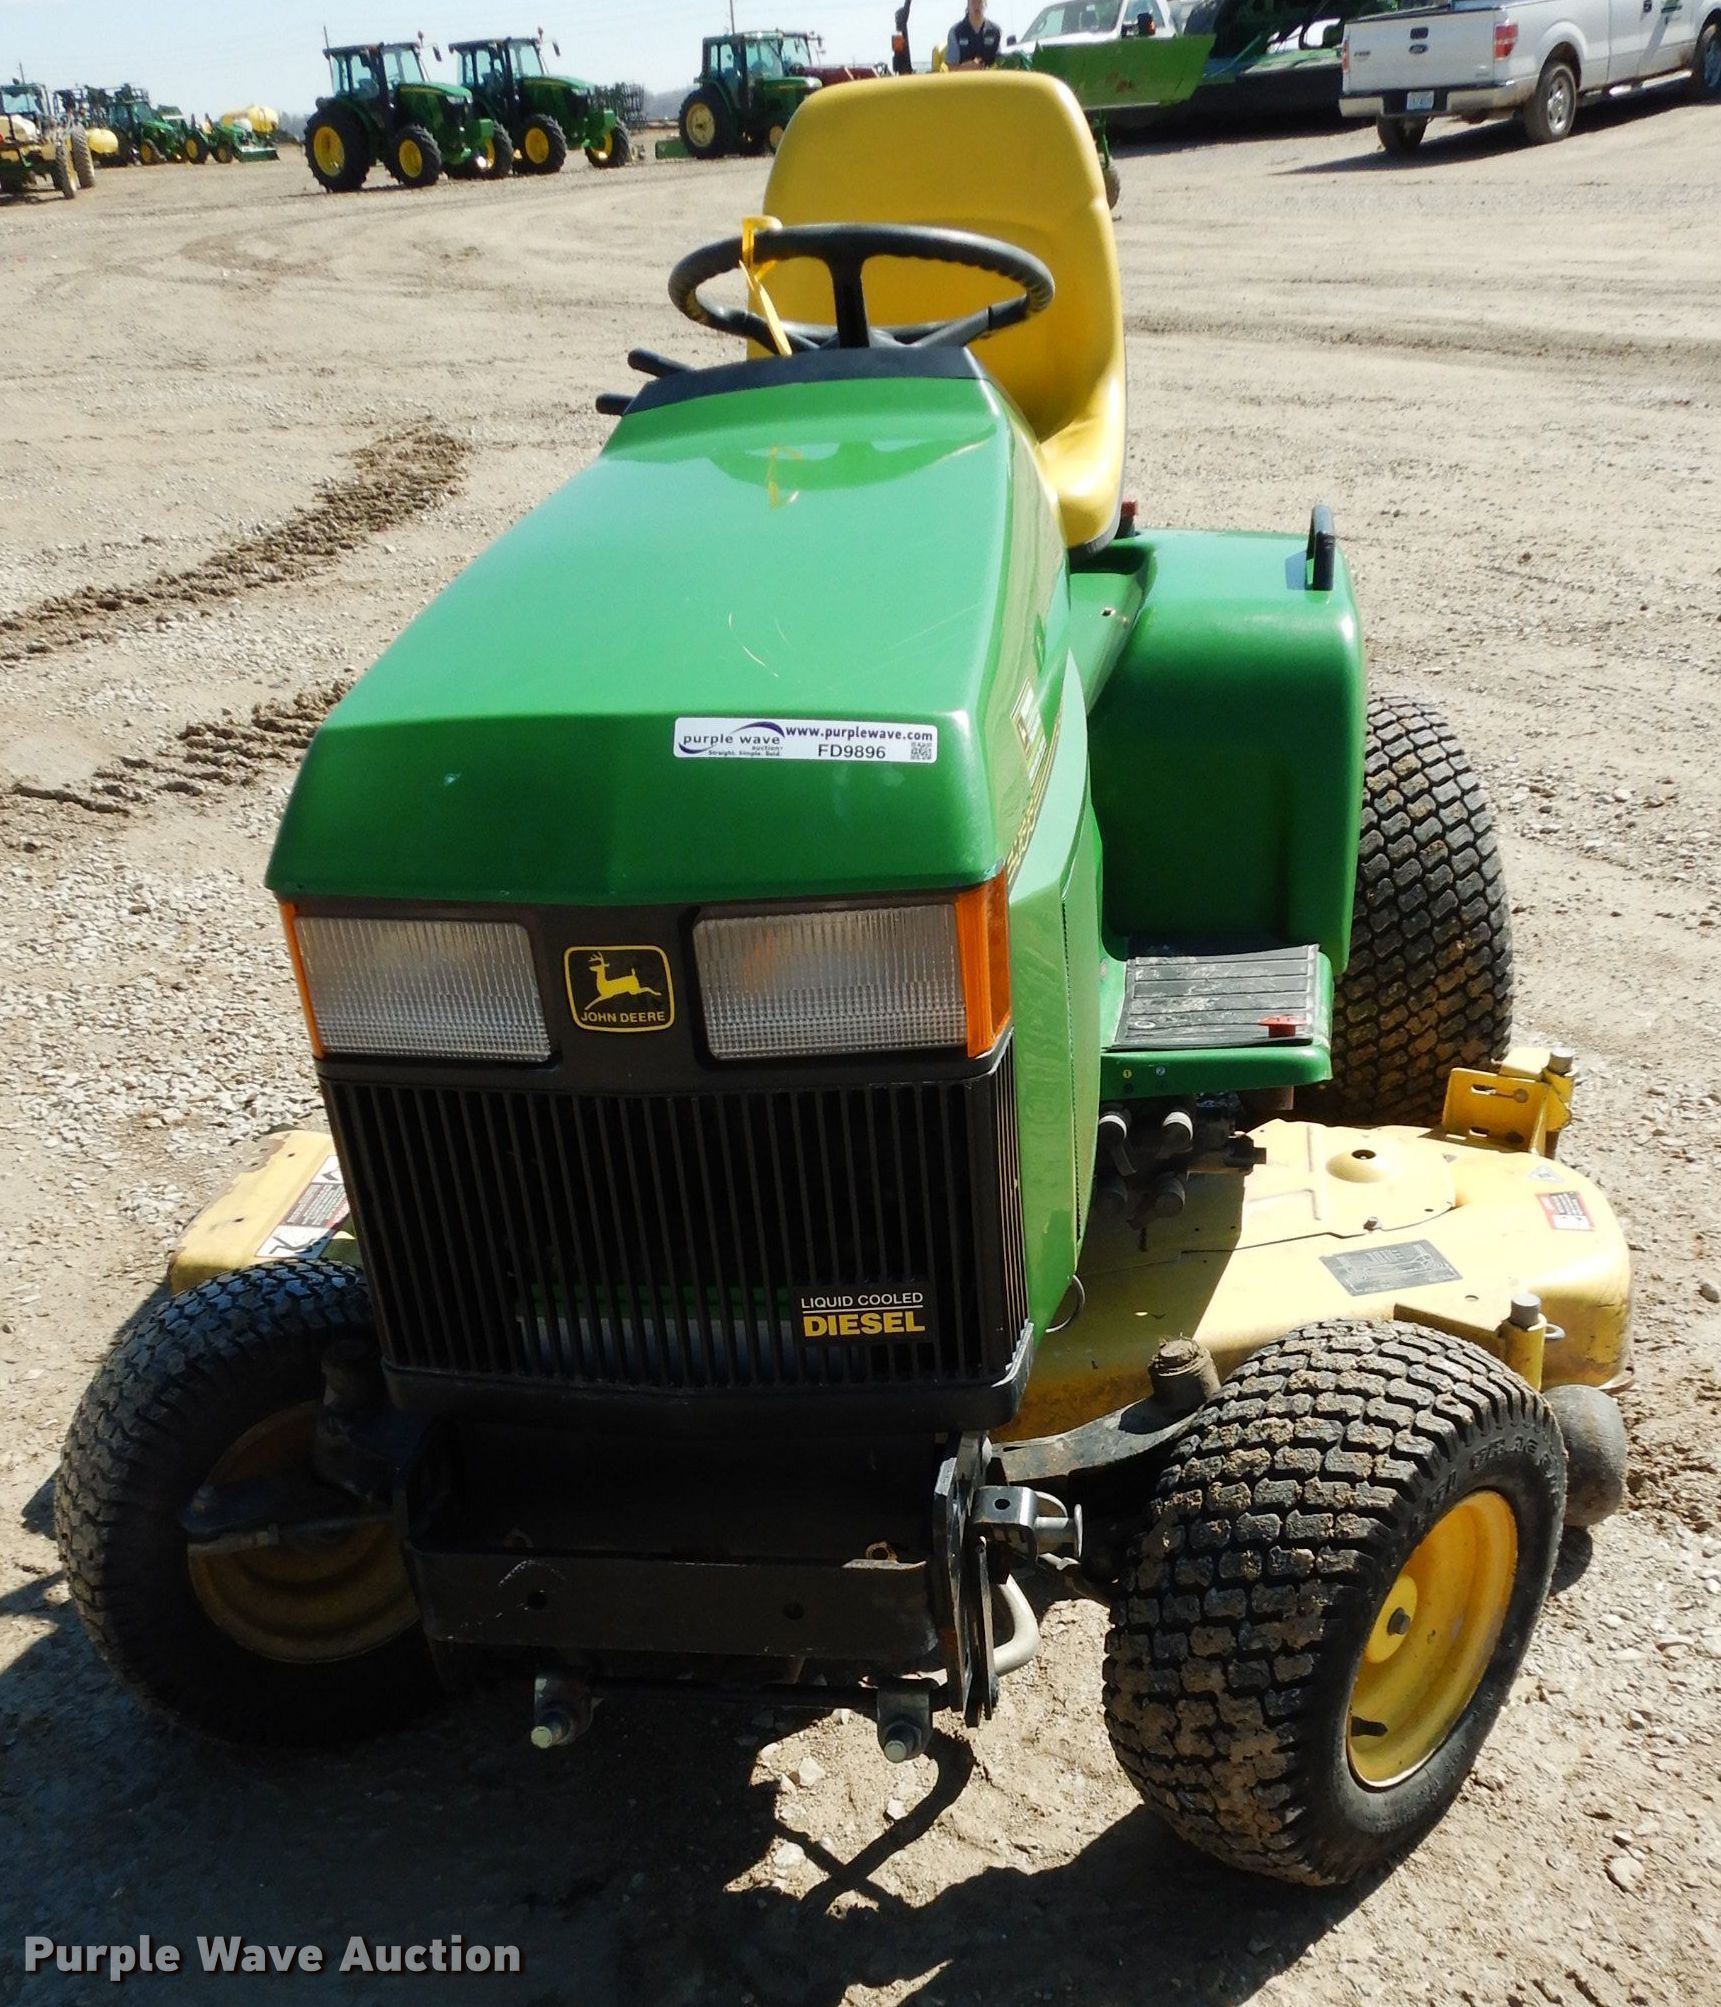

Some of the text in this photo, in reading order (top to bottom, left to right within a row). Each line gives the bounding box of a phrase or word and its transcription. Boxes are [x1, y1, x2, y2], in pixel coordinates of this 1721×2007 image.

[683, 734, 781, 745] purple wave
[786, 726, 933, 741] www.purplewave.com
[818, 743, 886, 759] FD9896
[581, 1011, 665, 1022] JOHN DEERE
[801, 1292, 924, 1308] LIQUID COOLED
[803, 1311, 926, 1337] DIESEL
